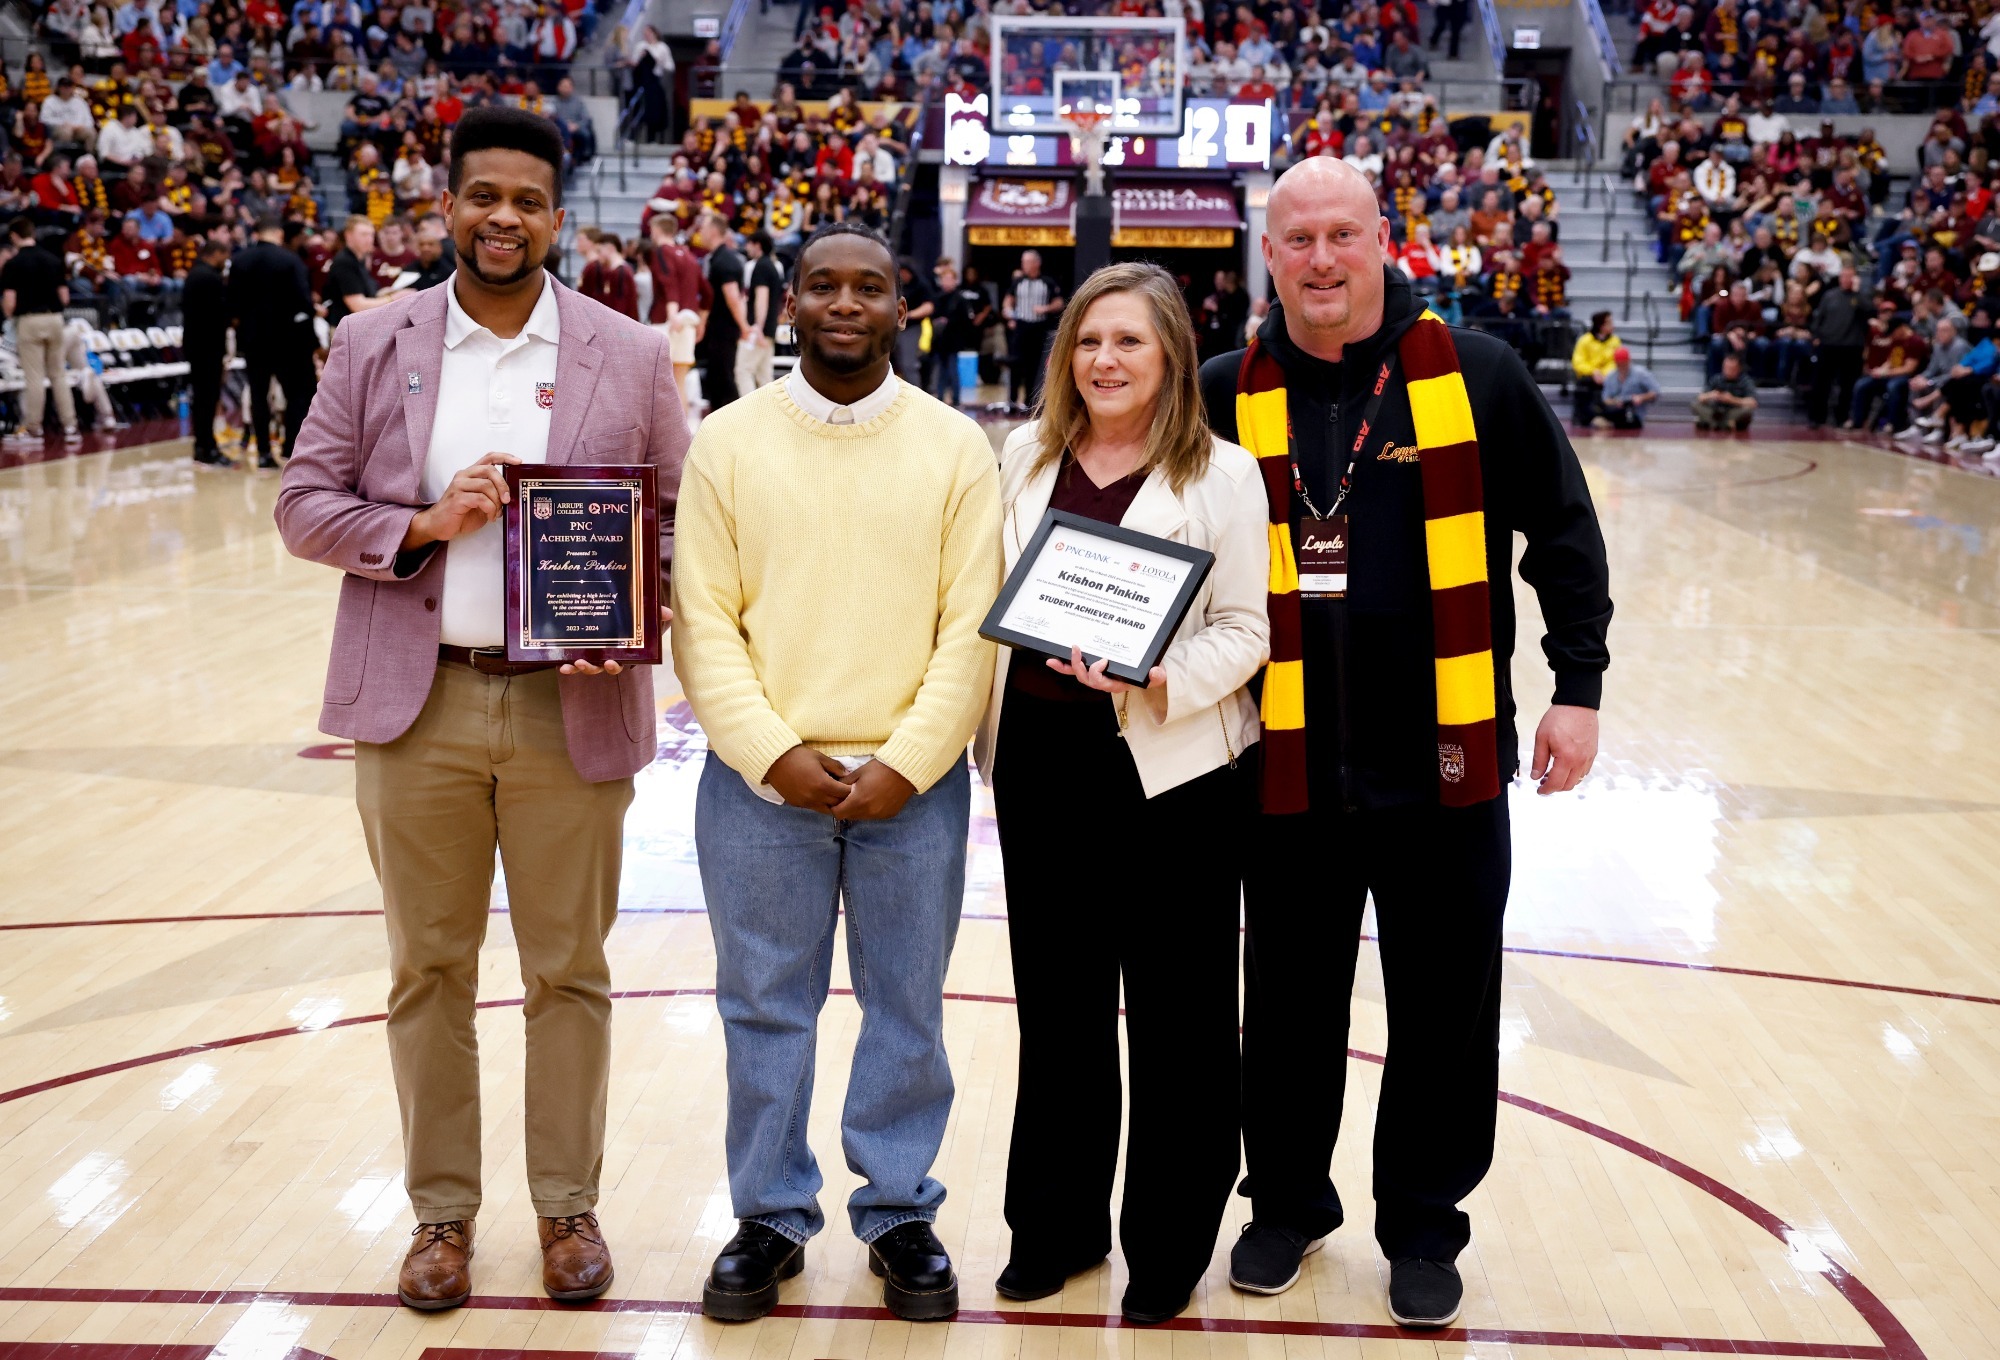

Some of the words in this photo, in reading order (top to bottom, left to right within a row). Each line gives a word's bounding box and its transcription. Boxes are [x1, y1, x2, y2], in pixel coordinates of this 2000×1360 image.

[1112, 188, 1197, 200] OYOLA
[1377, 442, 1418, 463] Loyo
[602, 503, 629, 514] PNC
[570, 521, 593, 531] PNC
[540, 533, 587, 542] ACHIEVER
[589, 533, 624, 543] AWARD
[1301, 534, 1345, 553] Loyola
[537, 559, 581, 571] Krishon
[584, 559, 627, 571] Pinkins
[1142, 565, 1176, 581] LOYOLA
[1057, 570, 1104, 591] Krishon
[1105, 583, 1151, 604] Pinkins
[1038, 594, 1074, 609] STUDENT
[1074, 604, 1115, 621] ACHIEVER
[1115, 616, 1146, 630] AWARD
